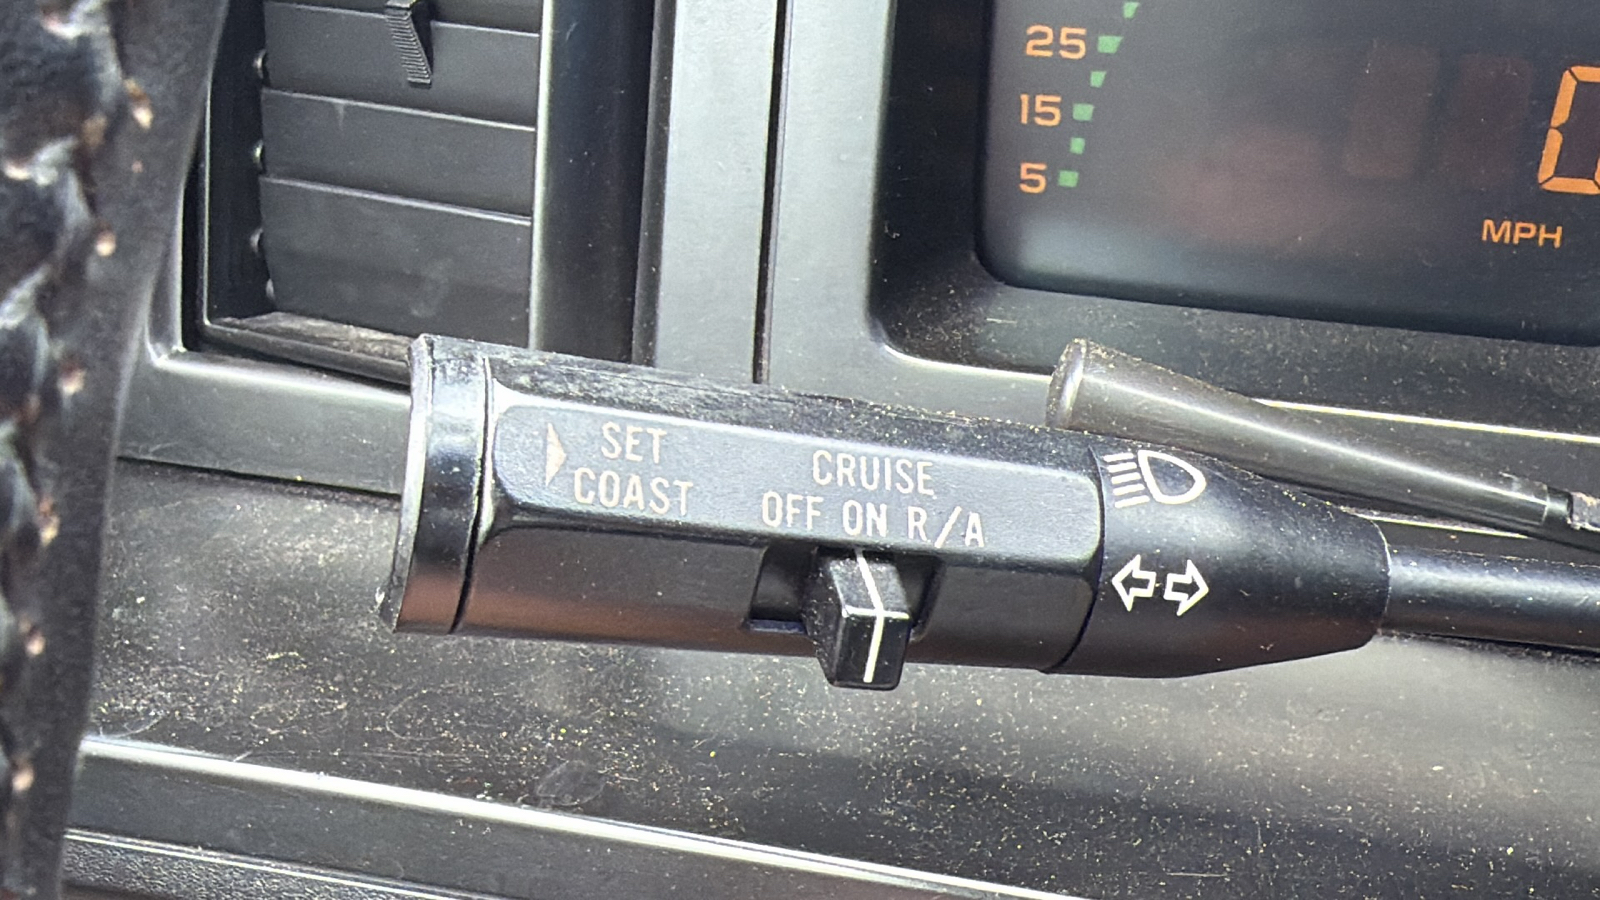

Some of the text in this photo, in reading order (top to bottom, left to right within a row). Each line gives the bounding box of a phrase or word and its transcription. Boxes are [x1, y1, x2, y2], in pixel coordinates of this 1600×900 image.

[1025, 24, 1087, 60] 25
[1019, 93, 1062, 128] 15
[1019, 162, 1047, 194] 5
[1481, 218, 1563, 249] MPH
[601, 421, 667, 464] SET
[574, 466, 694, 516] COAST
[812, 450, 935, 495] CRUISE
[761, 490, 986, 549] OFF ON R/A
